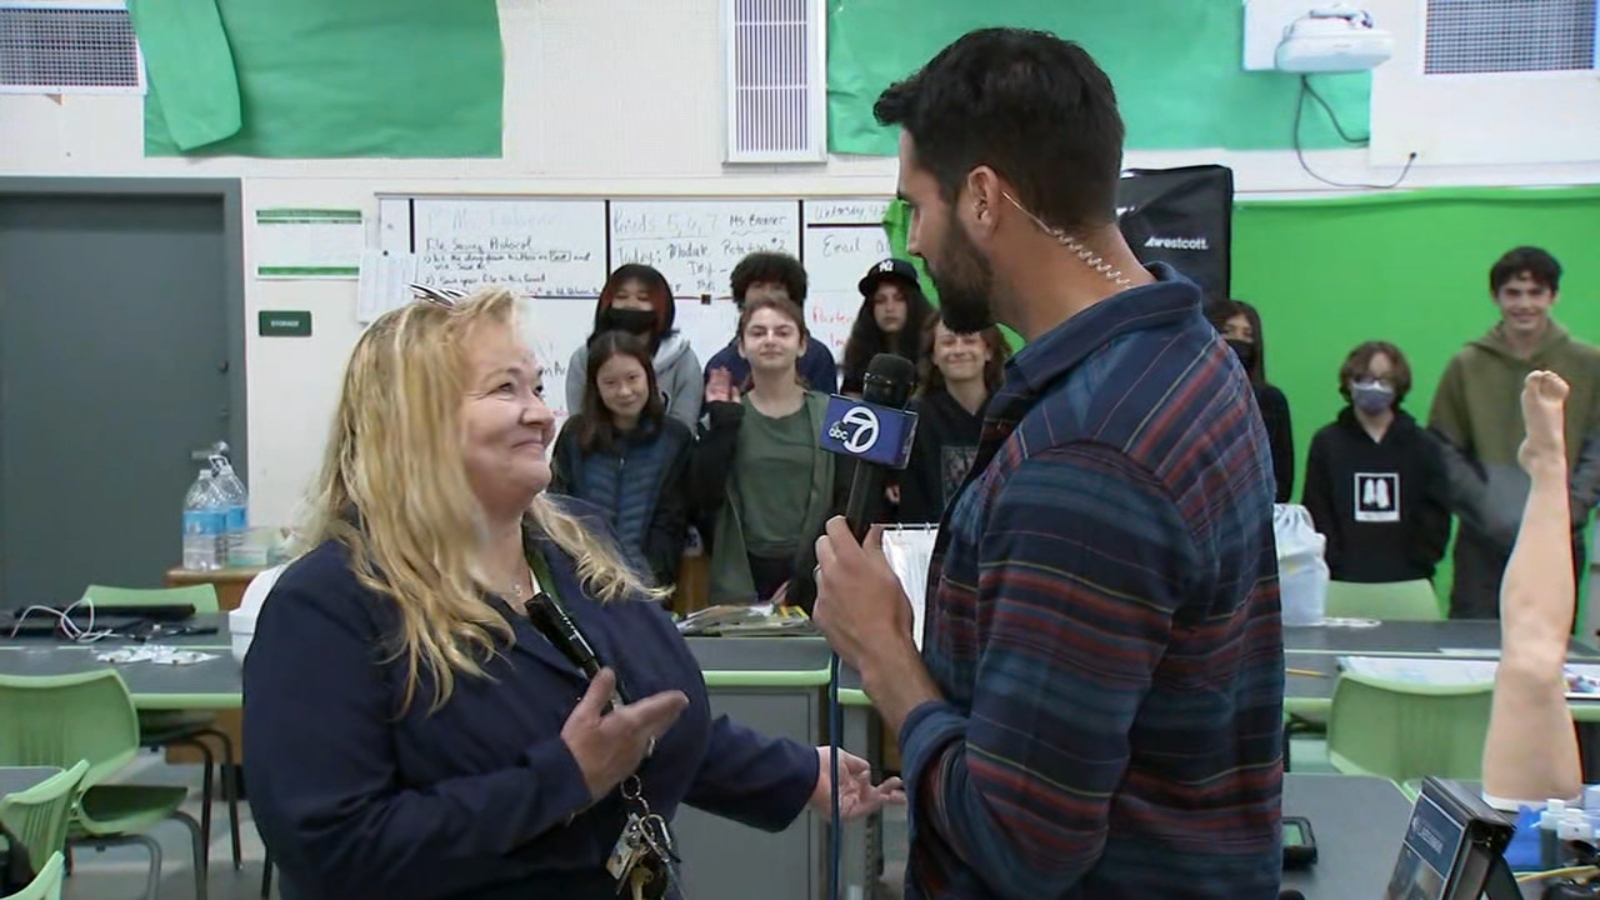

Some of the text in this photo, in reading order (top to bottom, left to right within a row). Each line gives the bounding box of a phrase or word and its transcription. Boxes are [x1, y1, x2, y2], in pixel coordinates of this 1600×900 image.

[822, 233, 861, 258] Email
[828, 423, 849, 441] abc
[842, 406, 880, 453] 7
